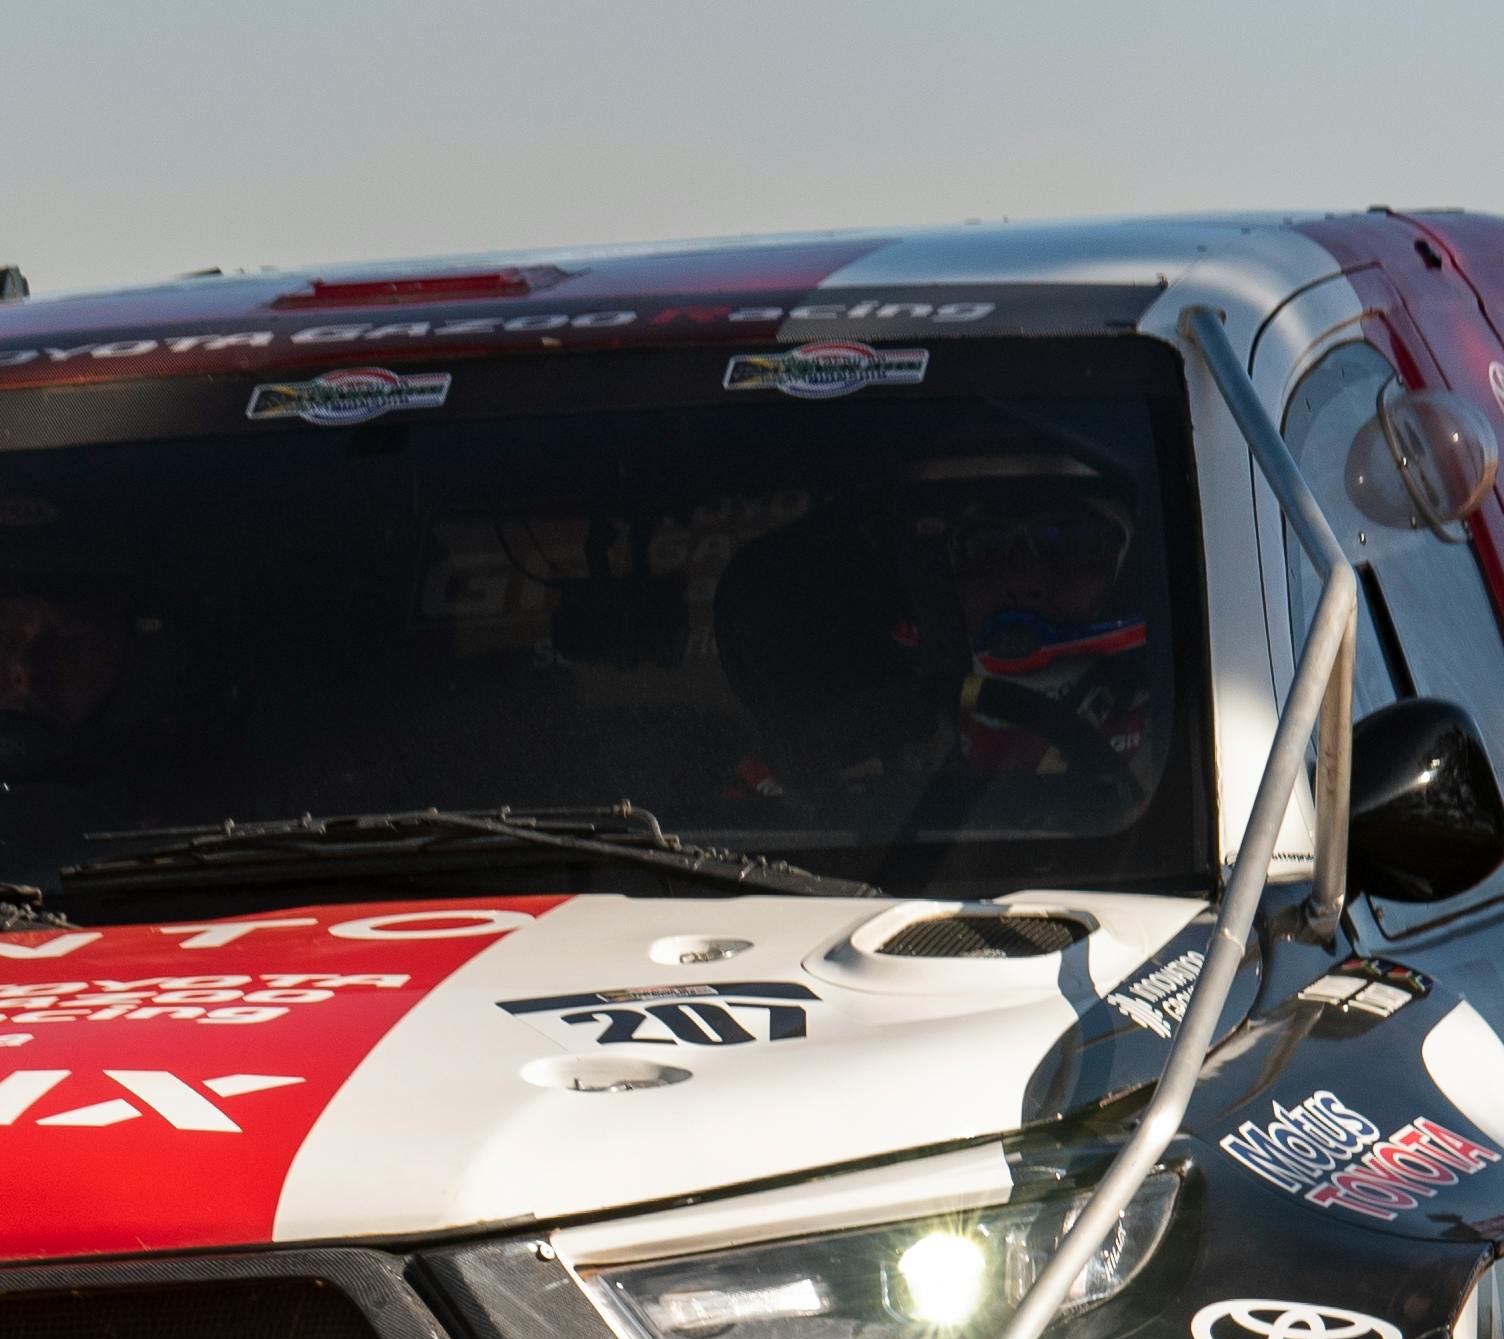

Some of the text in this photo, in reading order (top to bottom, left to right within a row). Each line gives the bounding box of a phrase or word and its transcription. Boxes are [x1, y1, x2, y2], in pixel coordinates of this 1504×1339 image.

[292, 310, 637, 344] GAZOO
[647, 299, 995, 328] Racing
[560, 1002, 807, 1046] 207
[1304, 1116, 1502, 1220] TOYOTA
